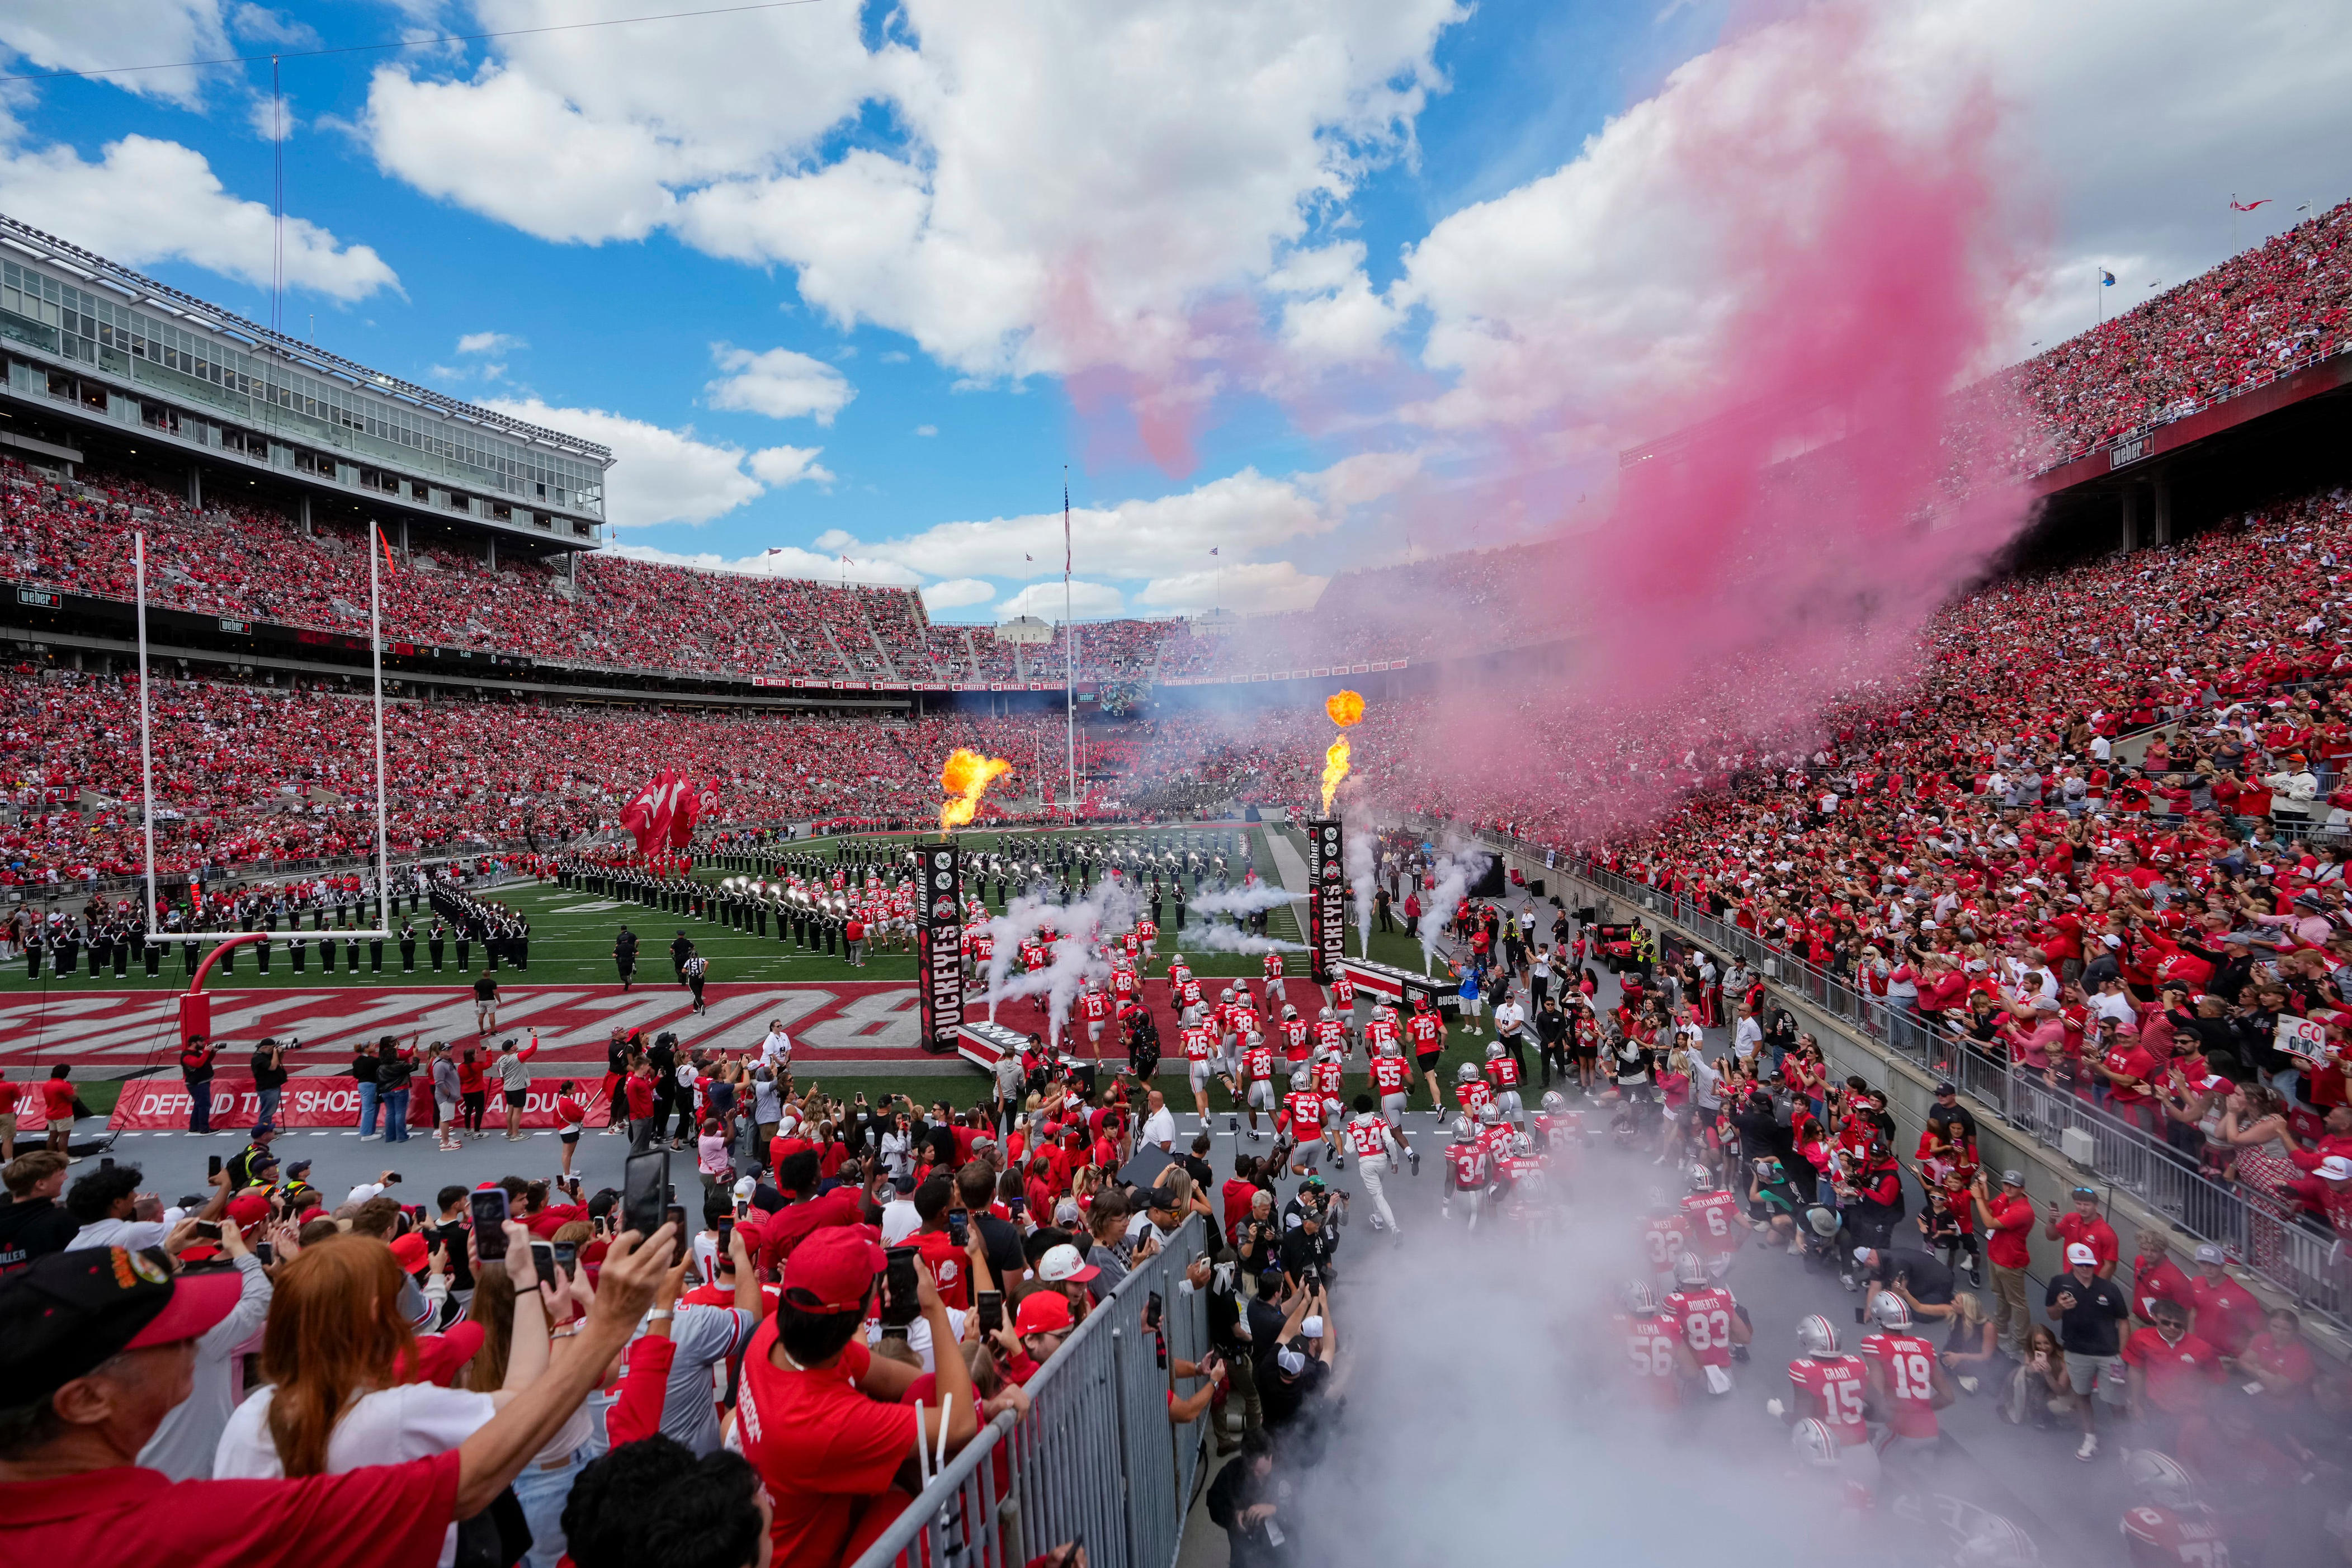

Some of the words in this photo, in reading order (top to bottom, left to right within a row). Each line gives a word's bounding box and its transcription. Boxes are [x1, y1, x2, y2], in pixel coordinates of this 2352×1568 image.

[2113, 441, 2142, 465] weber
[21, 590, 50, 605] weber
[222, 620, 243, 632] weber
[434, 648, 439, 657] 0
[491, 655, 496, 664] 0
[2150, 846, 2161, 861] 7
[865, 912, 871, 922] 7
[1044, 923, 1054, 933] 58
[1141, 924, 1154, 935] 37
[979, 943, 992, 955] 72
[1127, 938, 1137, 949] 18
[1028, 952, 1042, 964] 74
[1273, 961, 1282, 975] 17
[933, 925, 960, 1042] BUCKEYES
[1116, 976, 1132, 991] 48
[1184, 986, 1200, 1001] 96
[1339, 985, 1352, 1002] 13
[1088, 1000, 1102, 1017] 13
[1234, 1016, 1253, 1033] 38
[1414, 1022, 1435, 1040] 72
[2298, 1023, 2321, 1042] GO
[1291, 1027, 1307, 1046] 84
[1321, 1028, 1340, 1047] 25
[1374, 1028, 1391, 1047] 15
[1188, 1036, 1208, 1055] 46
[2289, 1036, 2314, 1055] OHIO
[1253, 1055, 1271, 1076] 28
[1503, 1067, 1514, 1079] 5
[1322, 1071, 1340, 1092] 30
[1377, 1066, 1401, 1086] 55
[1470, 1090, 1490, 1111] 87
[1296, 1101, 1319, 1123] 53
[1352, 1127, 1383, 1152] 24
[1489, 1127, 1505, 1139] STOVER
[1548, 1126, 1576, 1150] 65
[1458, 1154, 1486, 1182] 34
[1653, 1221, 1671, 1229] WEST
[1706, 1207, 1728, 1236] 6
[1646, 1231, 1683, 1263] 32
[1687, 1297, 1720, 1312] ROBERTS
[1637, 1324, 1660, 1335] KEMA
[1687, 1310, 1730, 1350] 83
[1890, 1340, 1921, 1353] WOODS
[1627, 1336, 1673, 1376] 56
[1823, 1366, 1851, 1380] GRADY
[1892, 1354, 1931, 1400] 19
[1822, 1380, 1863, 1425] 15
